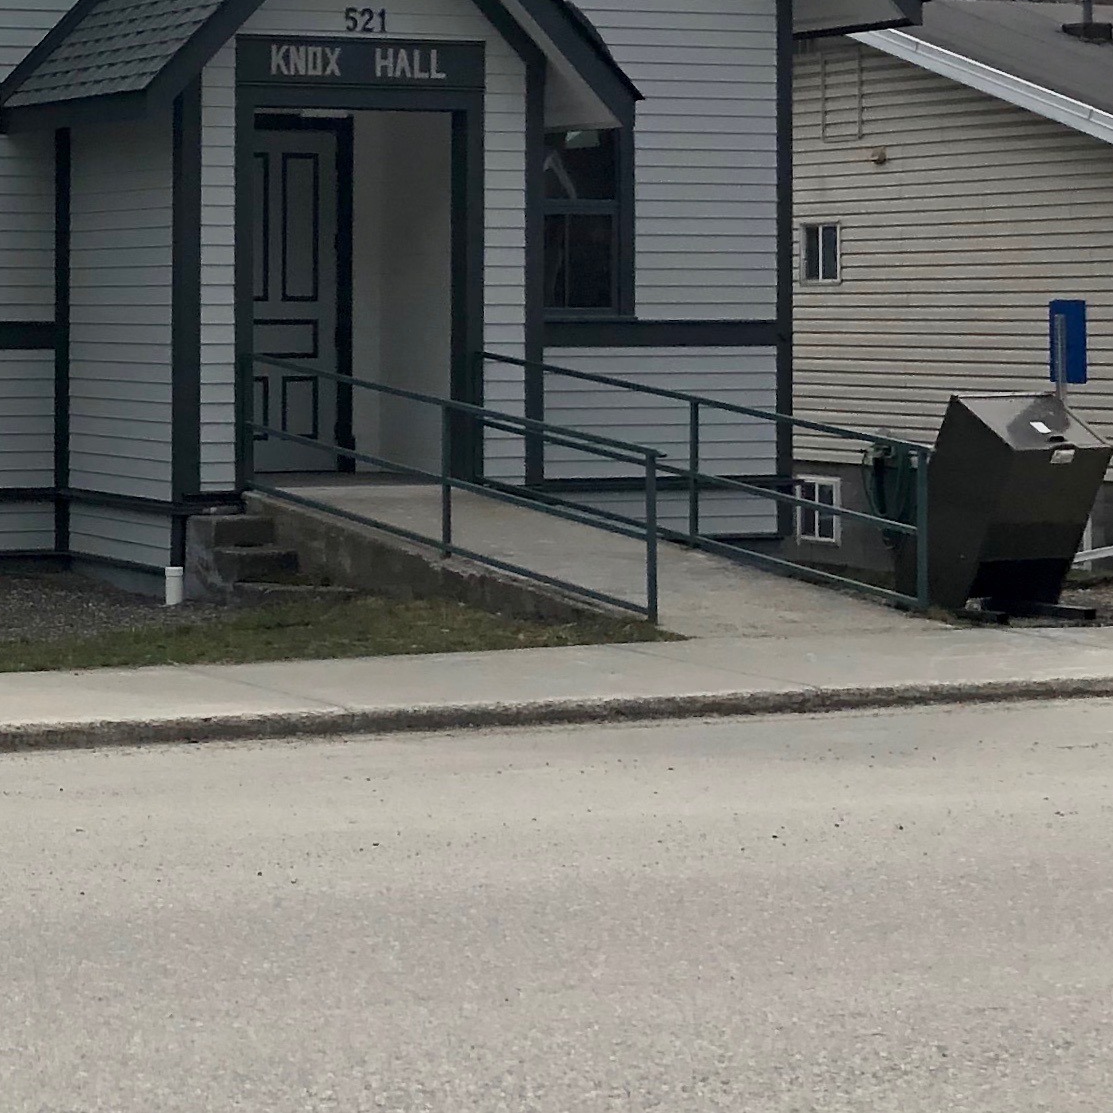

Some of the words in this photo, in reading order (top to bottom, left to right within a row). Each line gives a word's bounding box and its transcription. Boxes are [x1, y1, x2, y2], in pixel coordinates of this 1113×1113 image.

[344, 7, 387, 32] 521
[270, 45, 341, 76] KNOX
[374, 48, 446, 79] HALL
